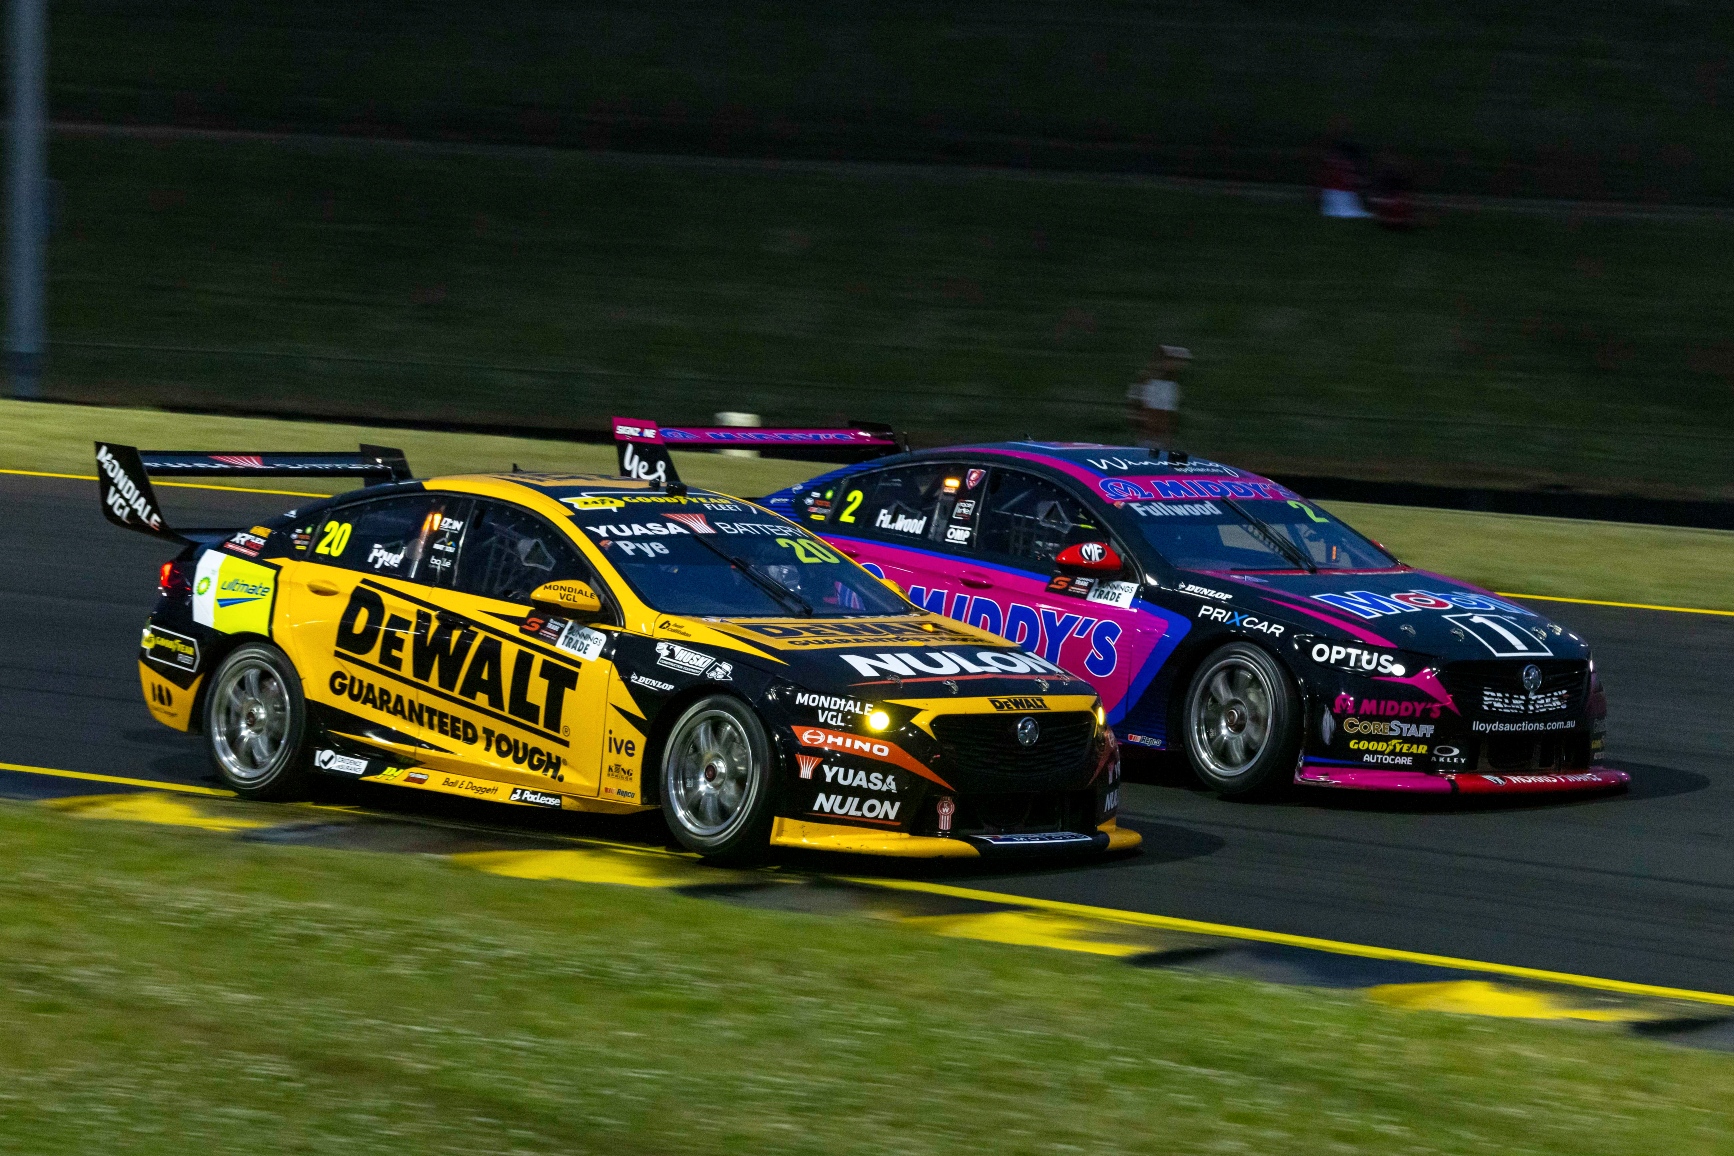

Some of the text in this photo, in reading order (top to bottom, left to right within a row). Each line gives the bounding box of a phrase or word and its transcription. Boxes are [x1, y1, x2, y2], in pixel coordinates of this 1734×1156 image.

[623, 442, 666, 482] Yes
[96, 445, 162, 531] MONDIALE
[106, 485, 131, 525] VGL
[703, 503, 742, 512] FLEET
[839, 489, 864, 523] 2
[1129, 500, 1223, 517] Fullwood
[1286, 500, 1330, 523] 2
[315, 520, 353, 557] 20
[585, 522, 691, 537] YUASA
[615, 540, 670, 558] Pye
[775, 537, 841, 564] 20
[1083, 545, 1105, 562] MF
[221, 577, 271, 597] ultimate
[543, 584, 596, 600] MONDIALE
[559, 593, 577, 602] VGL
[1092, 588, 1121, 602] TRADE
[1185, 584, 1234, 600] DUNLOP
[907, 585, 1122, 678] MIDDY'S
[1197, 605, 1285, 638] PRIXCAR
[562, 634, 590, 655] TRADE
[675, 648, 712, 669] HUSKI
[840, 650, 1066, 678] NULON
[1311, 643, 1394, 674] OPTUS
[637, 674, 675, 691] DUNLOP
[329, 670, 479, 746] GUARANTEED
[795, 692, 874, 716] MONDIALE
[1358, 698, 1441, 719] MIDDY'S
[817, 709, 845, 727] VGL
[1472, 720, 1576, 733] lloydsauctions.com.au
[608, 729, 636, 757] ive
[826, 734, 890, 757] HINO
[1349, 739, 1428, 754] GOODYEAR
[1363, 753, 1414, 765] AUTOCARE
[442, 777, 457, 787] Ball
[465, 782, 498, 795] Doggett
[822, 764, 898, 793] YUASA
[812, 792, 901, 820] NULON
